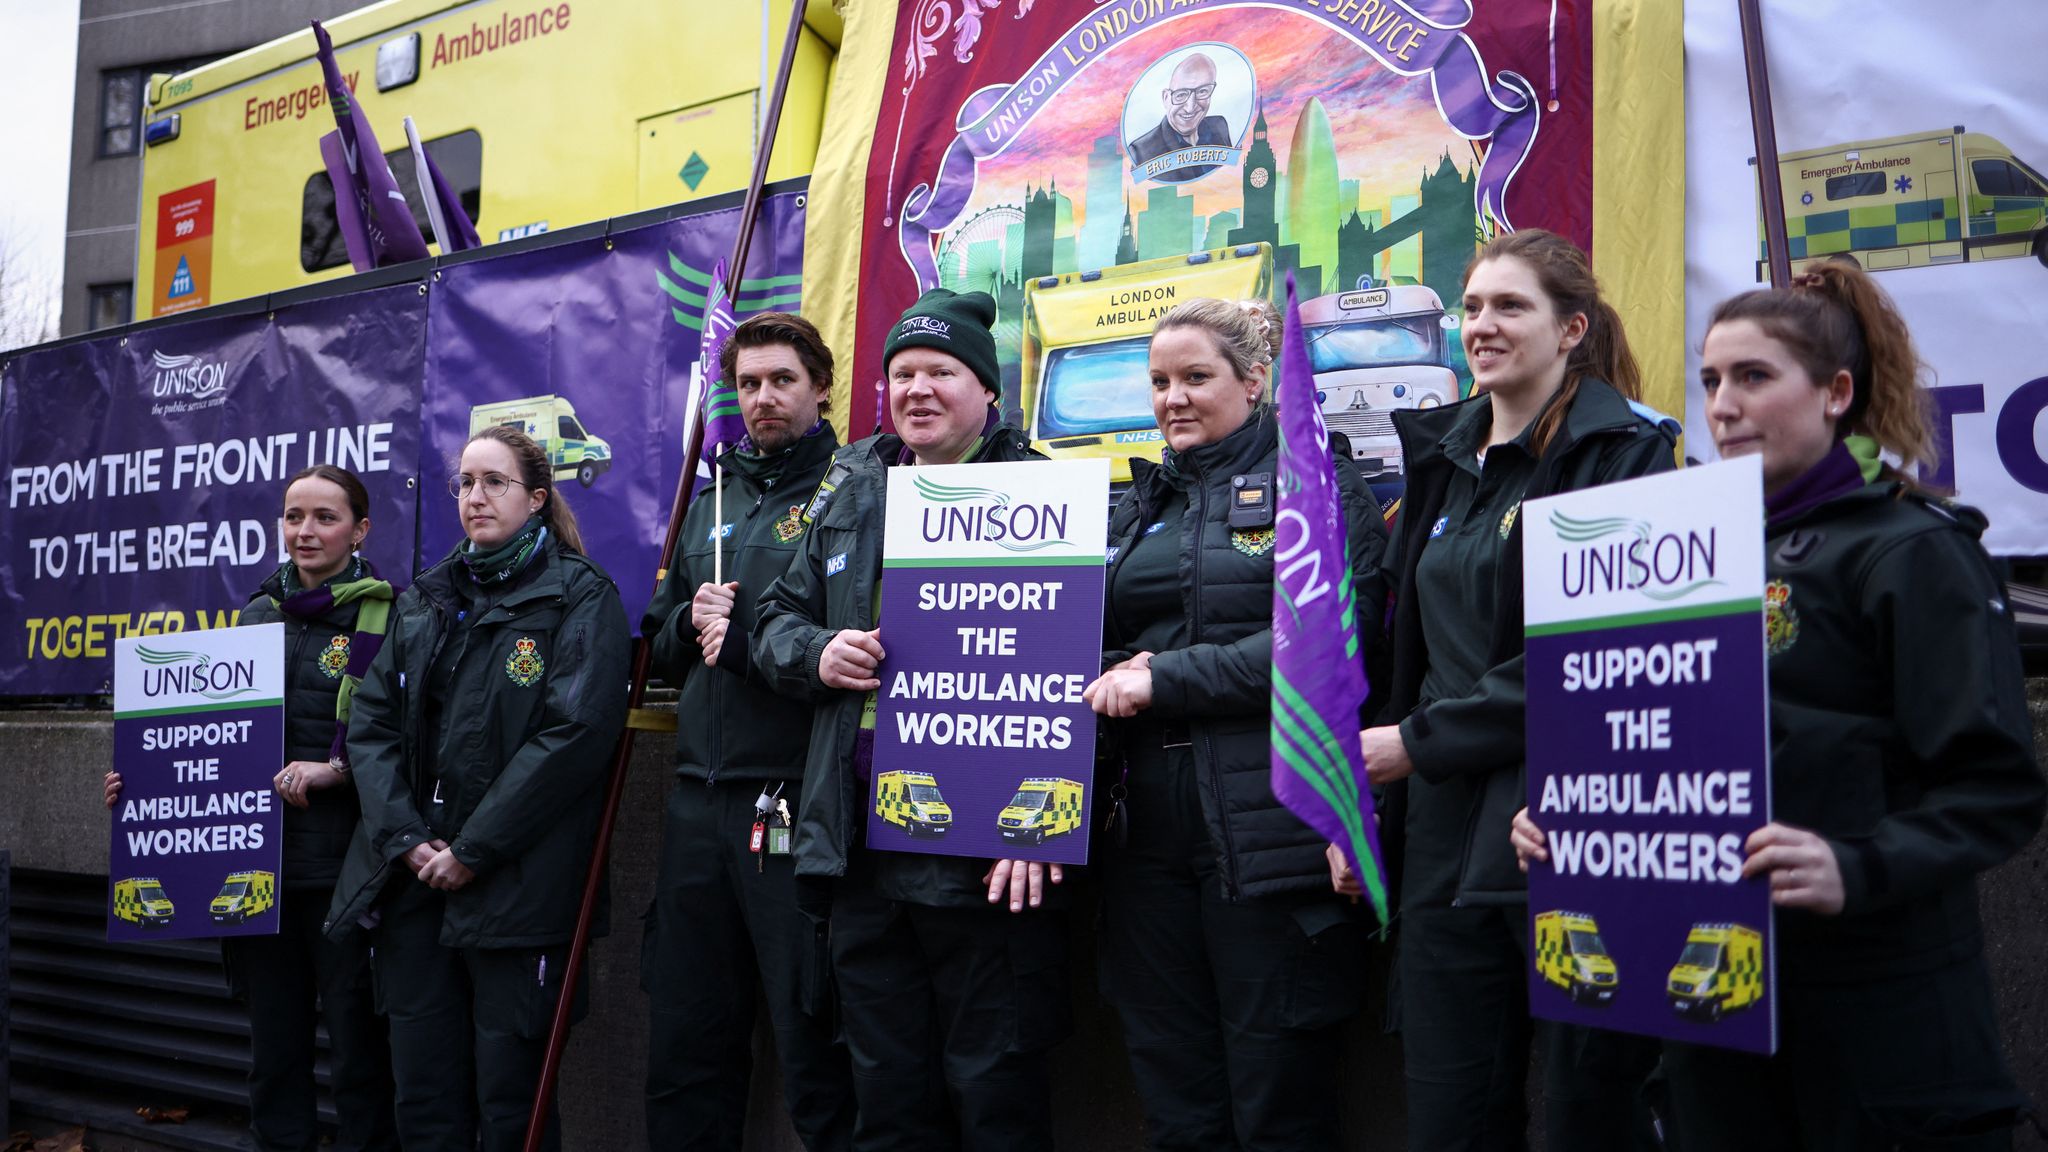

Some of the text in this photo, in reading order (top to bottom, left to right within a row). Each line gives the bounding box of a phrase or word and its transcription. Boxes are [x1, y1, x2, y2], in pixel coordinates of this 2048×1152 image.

[245, 2, 571, 131] Emergey Ambulance
[985, 0, 1429, 144] UNISON LONDON SERVICE
[168, 79, 193, 98] 7095
[1146, 149, 1228, 175] ERIC ROBERTS
[1800, 155, 1911, 180] Emergency Ambulance
[175, 218, 195, 238] 999
[173, 275, 190, 295] 111
[1111, 285, 1175, 306] LONDON
[1343, 294, 1383, 306] AMBULANCE
[901, 318, 951, 333] UNISON
[1096, 305, 1177, 328] AMBULAN
[153, 361, 228, 398] UNISON
[1122, 431, 1162, 442] NHS
[10, 458, 97, 508] FROM
[102, 448, 163, 497] THE
[172, 433, 297, 490] FRONT
[922, 503, 1067, 542] UNISON
[29, 536, 68, 580] TO
[75, 528, 138, 575] THE
[147, 519, 266, 571] BREAD
[827, 554, 845, 575] NHS
[1561, 527, 1717, 600] UNISON
[918, 582, 1062, 611] SUPPORT
[957, 627, 1017, 656] THE
[143, 660, 254, 697] UNISON
[1563, 639, 1718, 691] SUPPORT
[890, 670, 1084, 704] AMBULANCE
[142, 720, 253, 751] SUPPORT
[896, 711, 1072, 750] WORKERS
[1606, 708, 1671, 751] THE
[173, 758, 219, 783] THE
[121, 789, 272, 823] AMBULANCE
[1539, 771, 1752, 816] AMBULANCE
[127, 823, 264, 857] WORKERS
[1548, 830, 1743, 885] WORKERS
